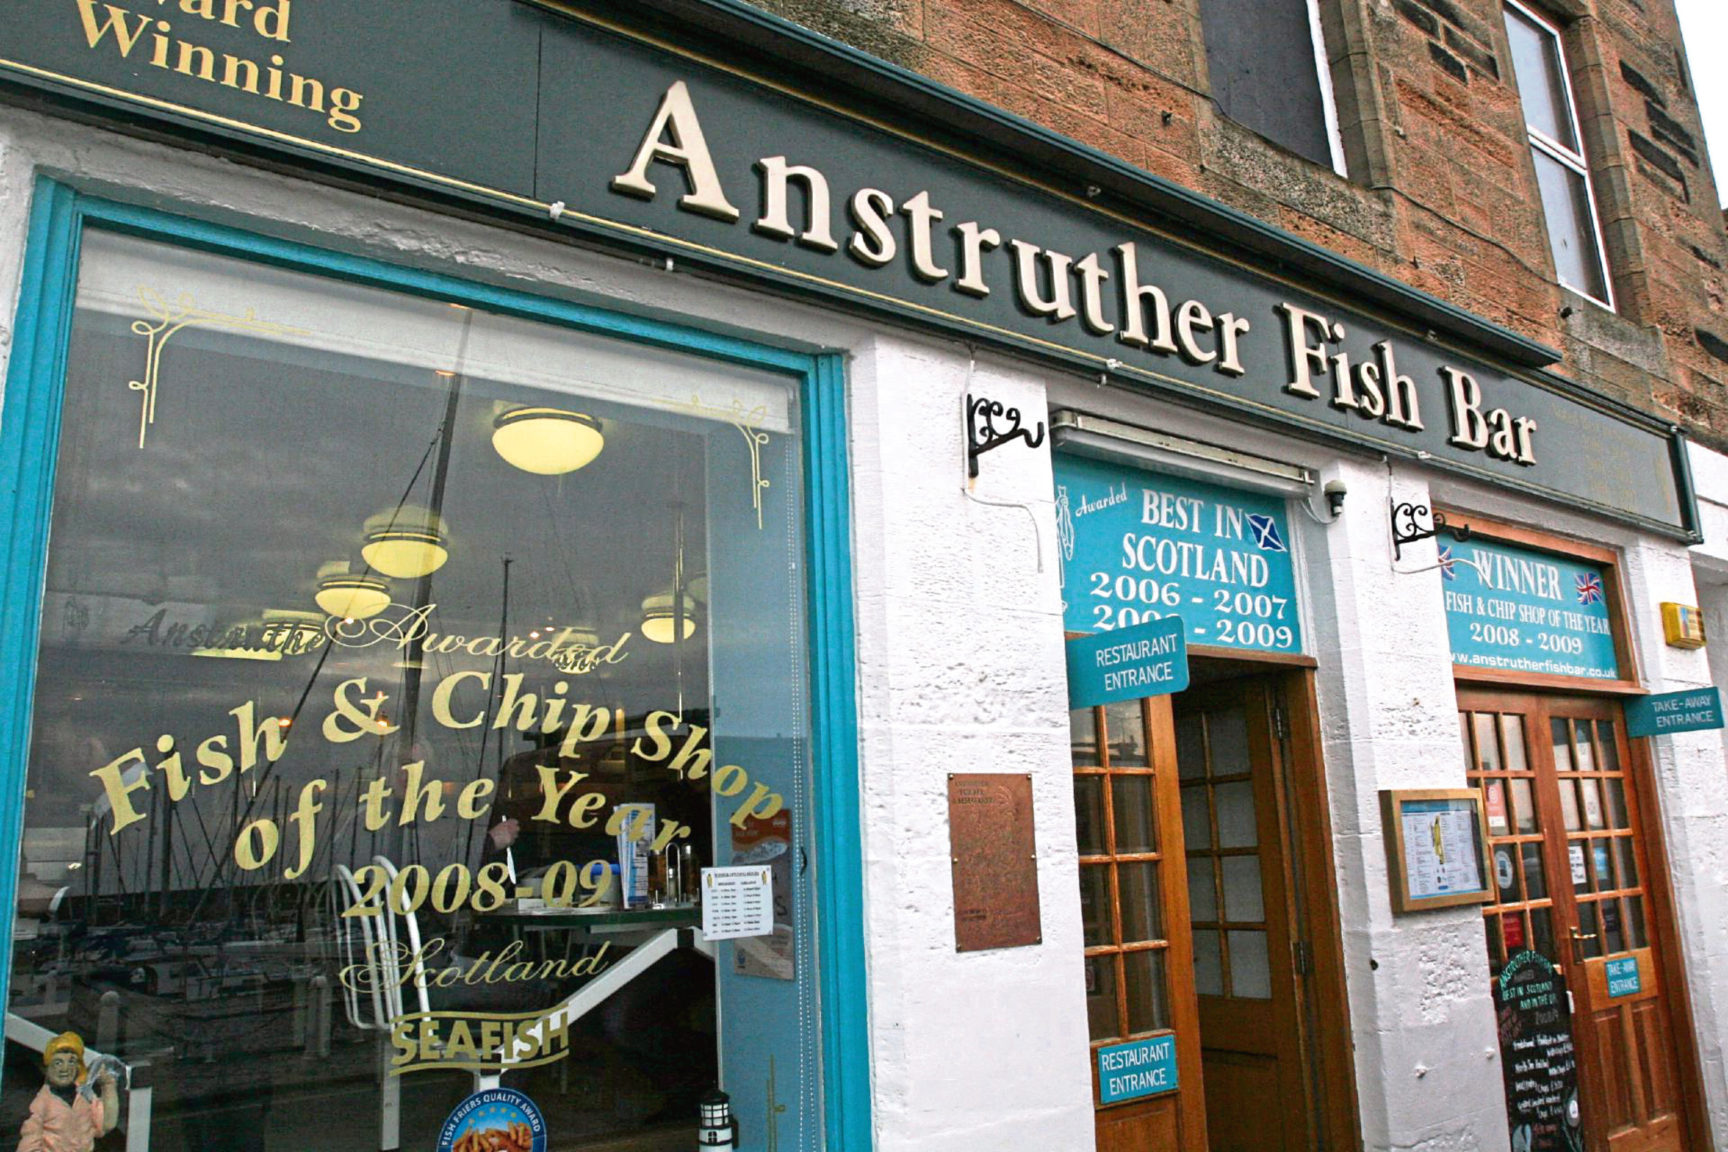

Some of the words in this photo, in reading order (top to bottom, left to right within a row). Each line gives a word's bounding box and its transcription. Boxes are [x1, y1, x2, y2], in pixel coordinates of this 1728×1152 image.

[158, 0, 291, 43] ard
[76, 0, 363, 133] Winning
[610, 80, 1250, 376] Anstruther
[1281, 302, 1425, 431] Fish
[1442, 366, 1537, 466] Bar
[1075, 482, 1128, 516] Awarded
[1142, 488, 1204, 533] BEST
[1215, 503, 1243, 540] IN
[1122, 533, 1269, 588] SCOTLAND
[1472, 549, 1564, 600] WINNER
[1090, 572, 1181, 606] 2006
[1214, 589, 1288, 619] 2007
[1446, 591, 1473, 614] FISH
[1476, 596, 1486, 616] &
[1487, 598, 1516, 620] CHIP
[1519, 604, 1546, 625] SHOP
[1548, 609, 1561, 627] OF
[1562, 611, 1584, 632] THE
[1584, 615, 1611, 635] YEAR
[325, 603, 632, 665] Awarded
[1095, 633, 1178, 668] RESTAURANT
[1216, 619, 1293, 648] 2009
[1469, 622, 1520, 646] 2008
[1538, 632, 1583, 654] 2009
[1105, 662, 1173, 691] ENTRANCE
[1652, 694, 1712, 713] TAKE-AWAY
[1656, 710, 1715, 728] ENTRANCE
[89, 700, 287, 835] Fish
[322, 677, 400, 743] &
[432, 671, 611, 758] Chip
[631, 710, 785, 829] Shop
[234, 779, 327, 880] of
[354, 761, 494, 832] the
[531, 765, 691, 852] Year
[341, 859, 613, 918] 2008-09
[339, 938, 611, 993] Scotland
[390, 1011, 569, 1065] SEAFISH
[1102, 1042, 1171, 1072] RESTAURANT
[1109, 1067, 1167, 1096] ENTRANCE
[441, 1123, 456, 1146] FISH
[453, 1097, 481, 1123] FRIERS
[483, 1092, 521, 1106] QUALITY
[520, 1103, 541, 1132] AWARD
